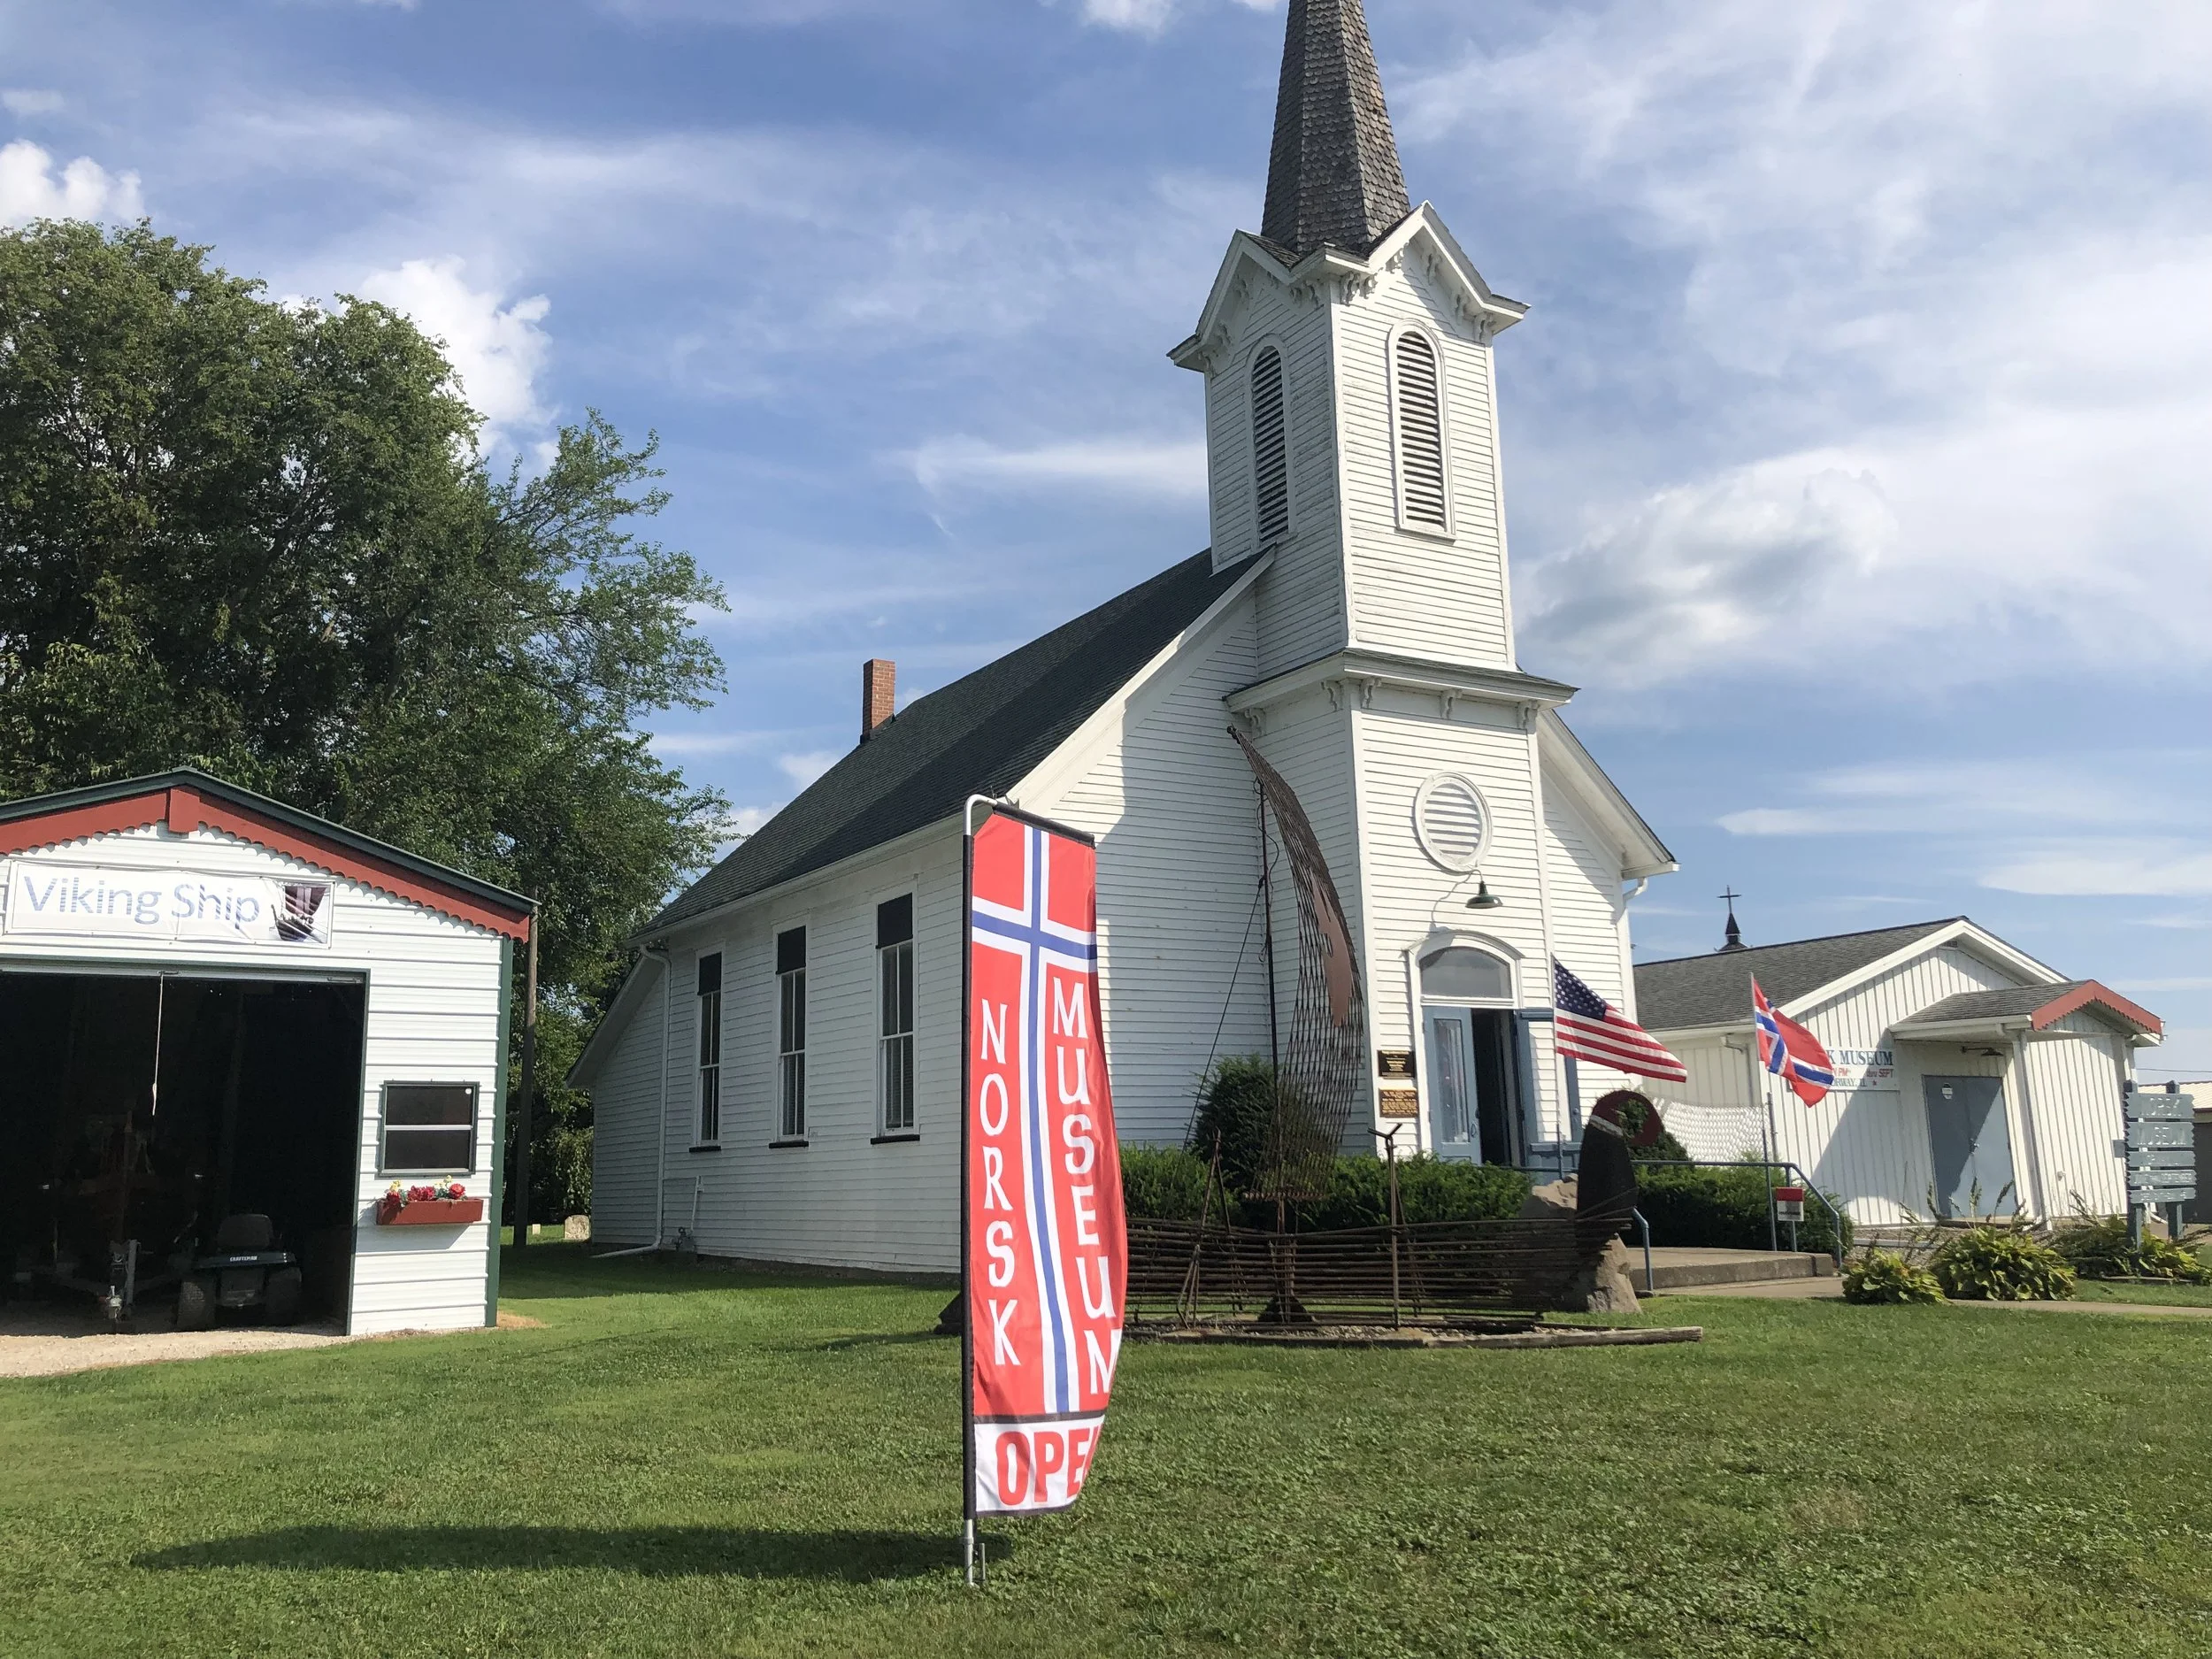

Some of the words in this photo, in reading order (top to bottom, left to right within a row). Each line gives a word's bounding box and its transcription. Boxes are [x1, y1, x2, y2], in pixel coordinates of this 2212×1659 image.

[24, 876, 162, 925] Viking
[172, 882, 261, 929] Ship
[1839, 1050, 1893, 1065] MUSEUM
[979, 999, 1021, 1366] NORSK
